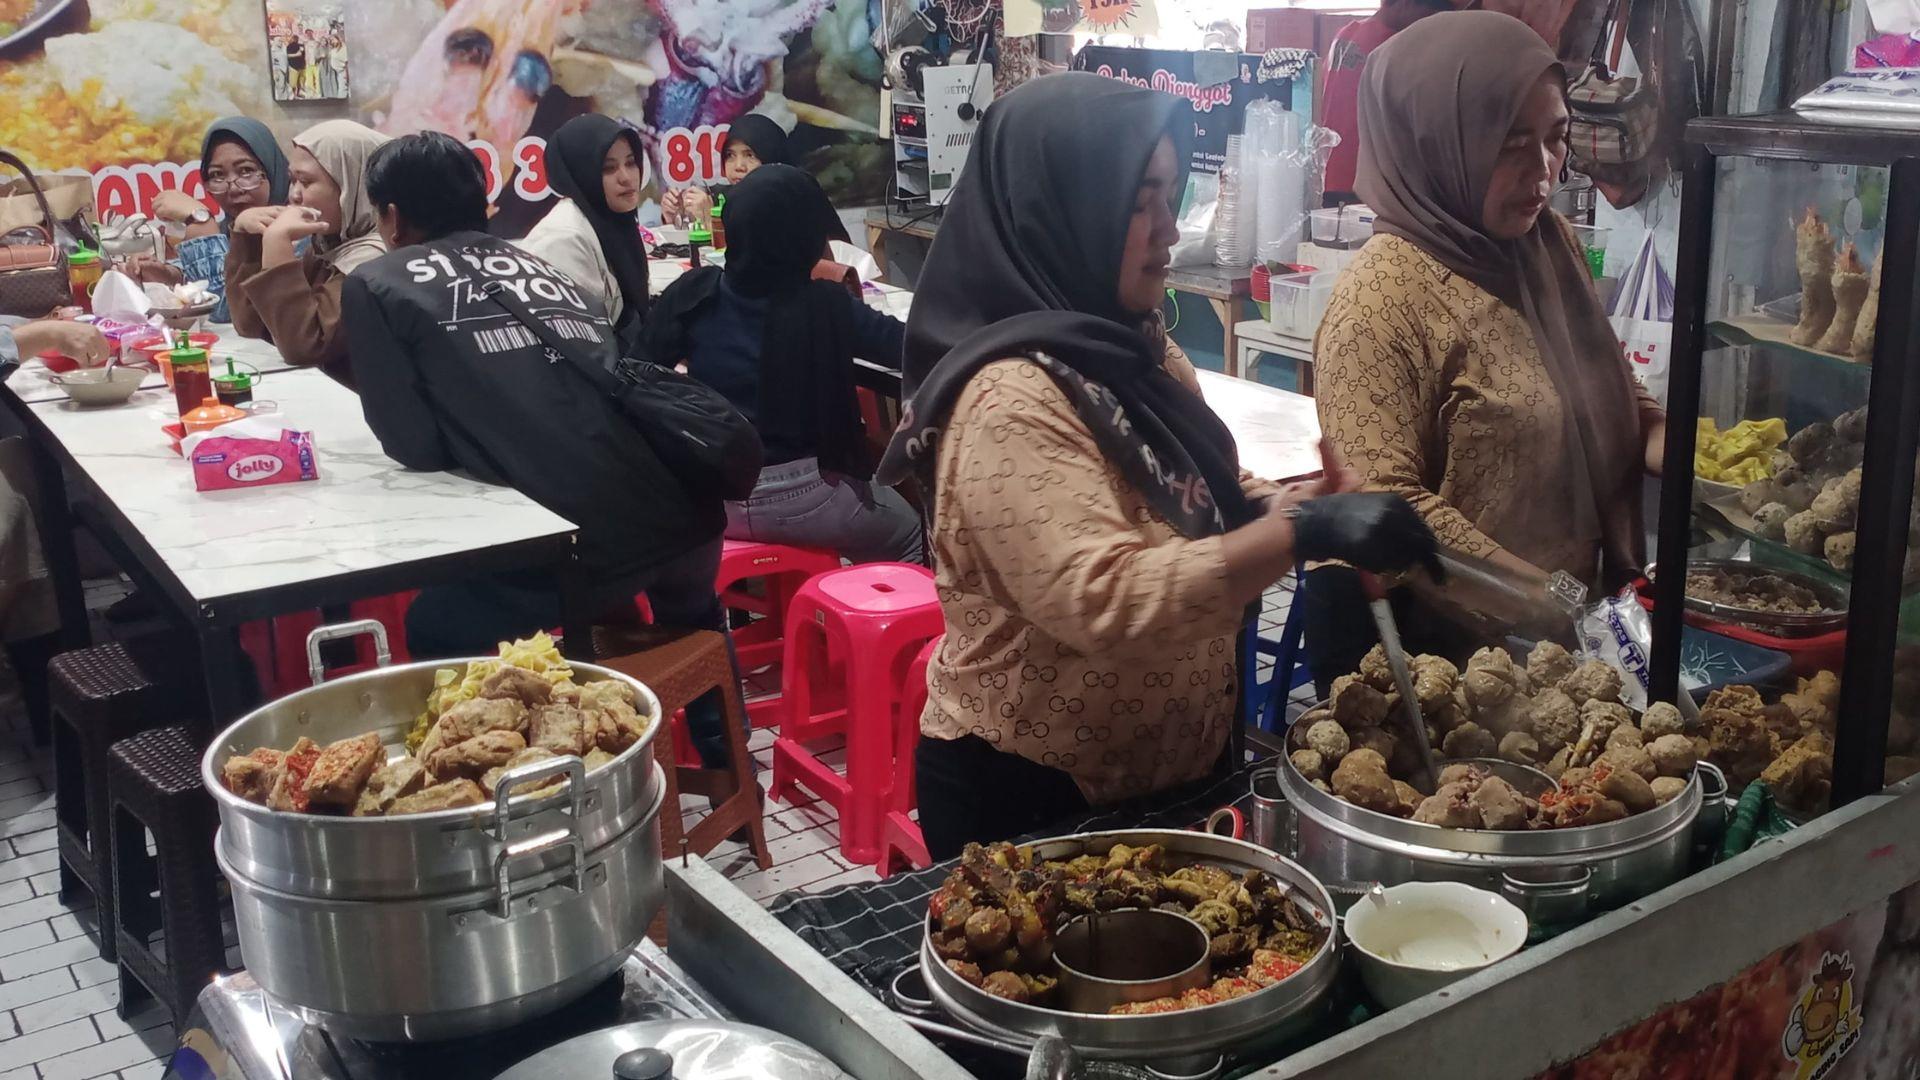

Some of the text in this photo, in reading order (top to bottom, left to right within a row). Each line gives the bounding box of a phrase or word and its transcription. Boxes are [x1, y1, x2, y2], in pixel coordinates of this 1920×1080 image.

[500, 277, 587, 310] YOU
[236, 459, 275, 477] jolly
[1839, 1028, 1859, 1054] SAPI
